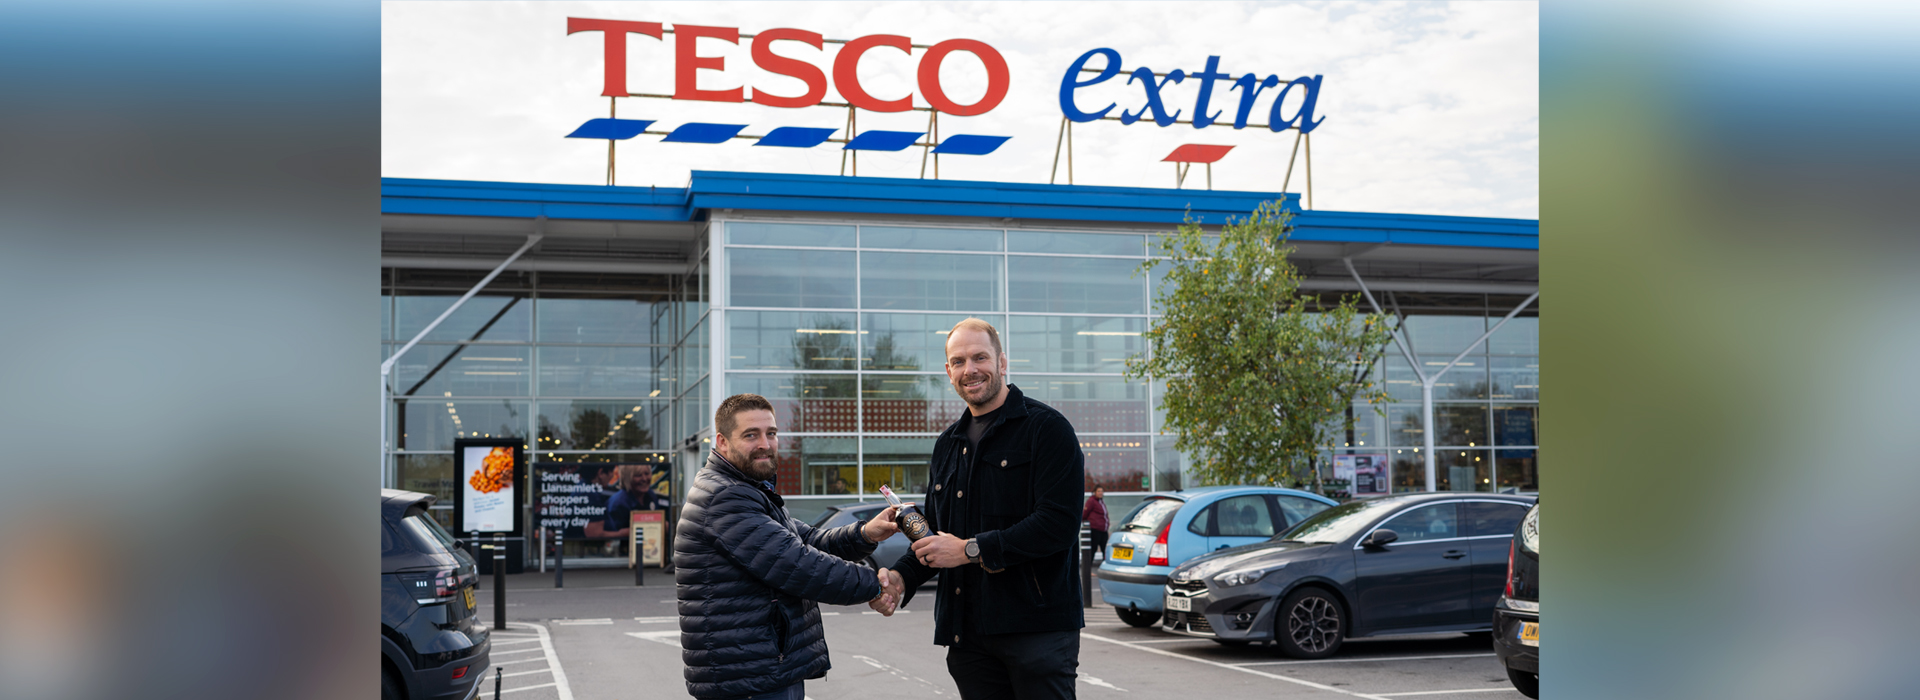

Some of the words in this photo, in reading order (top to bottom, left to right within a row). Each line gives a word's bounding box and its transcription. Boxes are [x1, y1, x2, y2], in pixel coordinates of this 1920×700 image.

[567, 16, 1010, 117] TESCO
[1058, 47, 1326, 135] extra
[541, 471, 580, 483] Serving
[541, 482, 604, 493] Llansamlet's
[541, 494, 590, 506] shoppers
[541, 507, 548, 516] a
[549, 505, 572, 516] little
[573, 505, 607, 516] better
[541, 518, 570, 529] every
[571, 517, 590, 529] day
